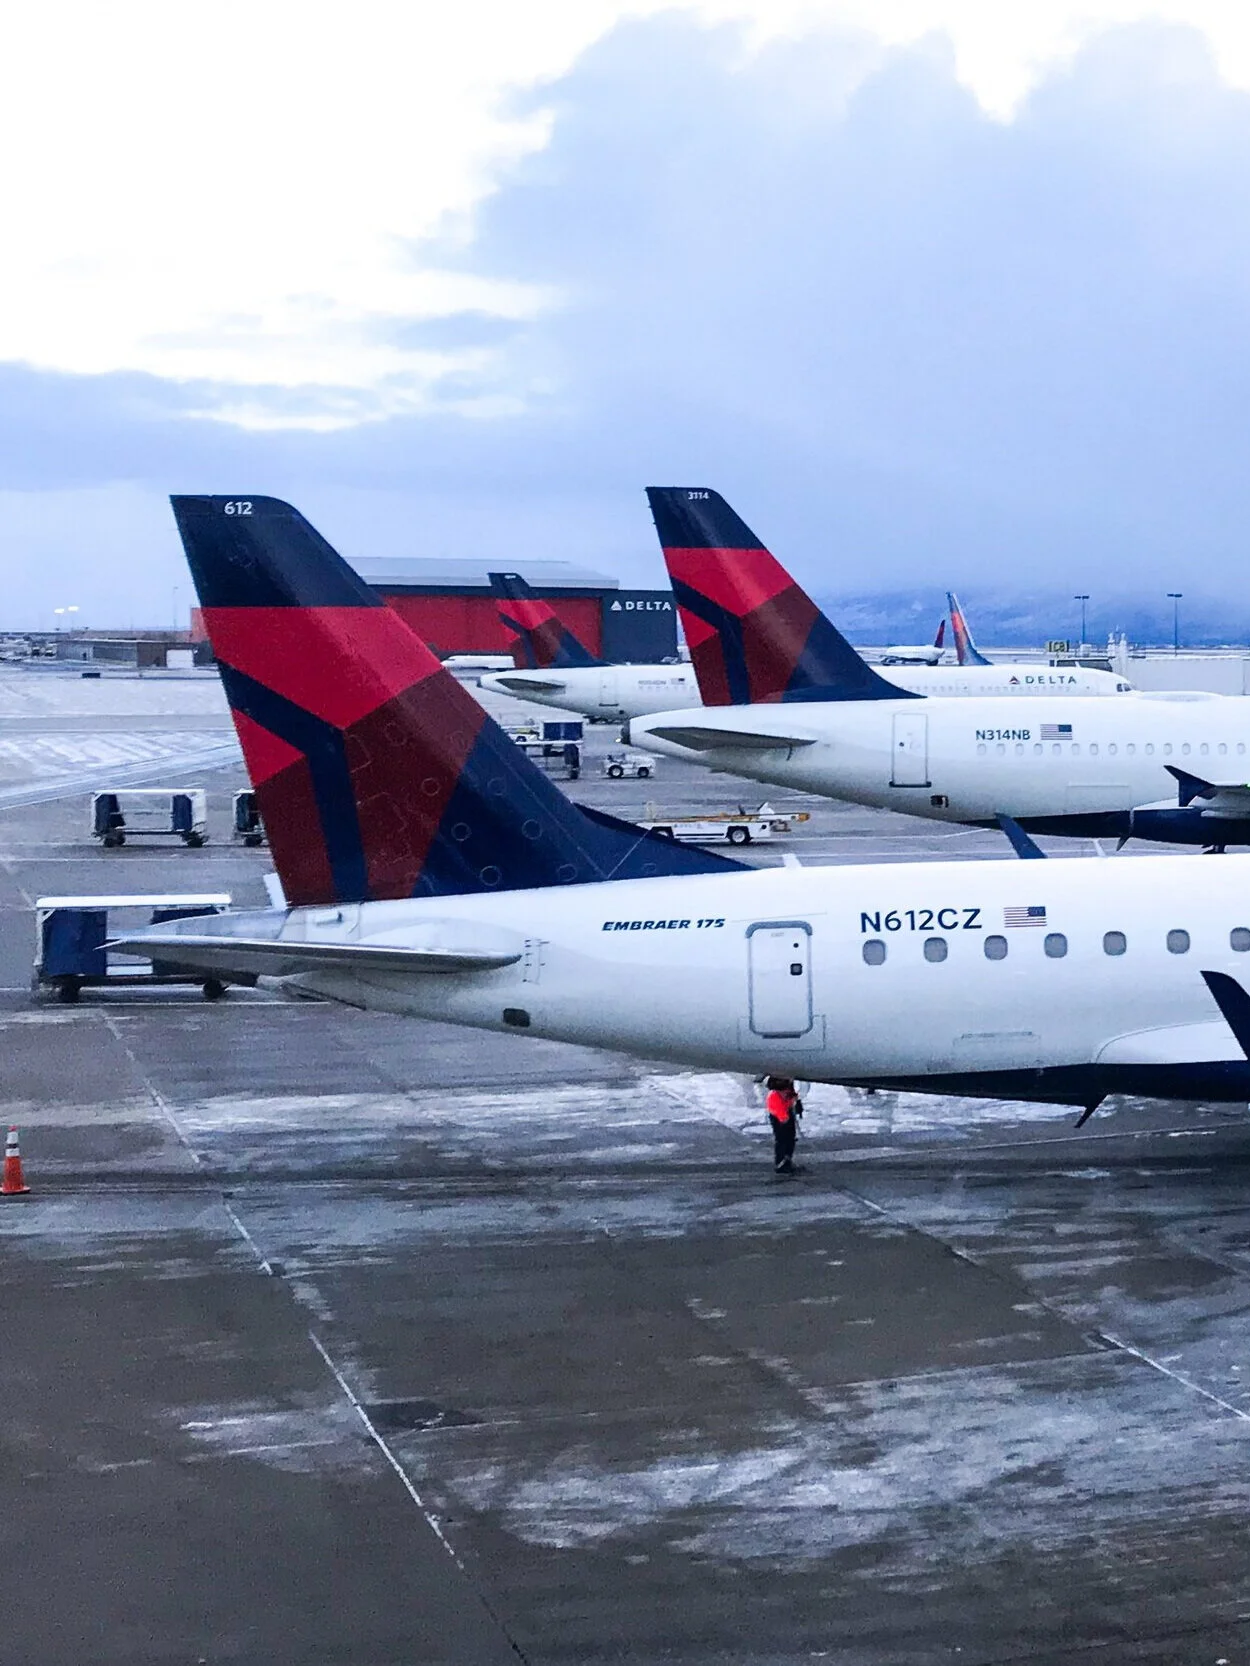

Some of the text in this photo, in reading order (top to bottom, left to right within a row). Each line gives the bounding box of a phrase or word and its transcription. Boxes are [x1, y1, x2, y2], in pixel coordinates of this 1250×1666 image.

[224, 501, 252, 515] 612
[625, 601, 672, 611] DELTA
[1025, 675, 1077, 684] DELTA
[975, 729, 1031, 740] N314NB
[602, 918, 726, 931] EMBRAER 175
[860, 908, 983, 933] N612CZ
